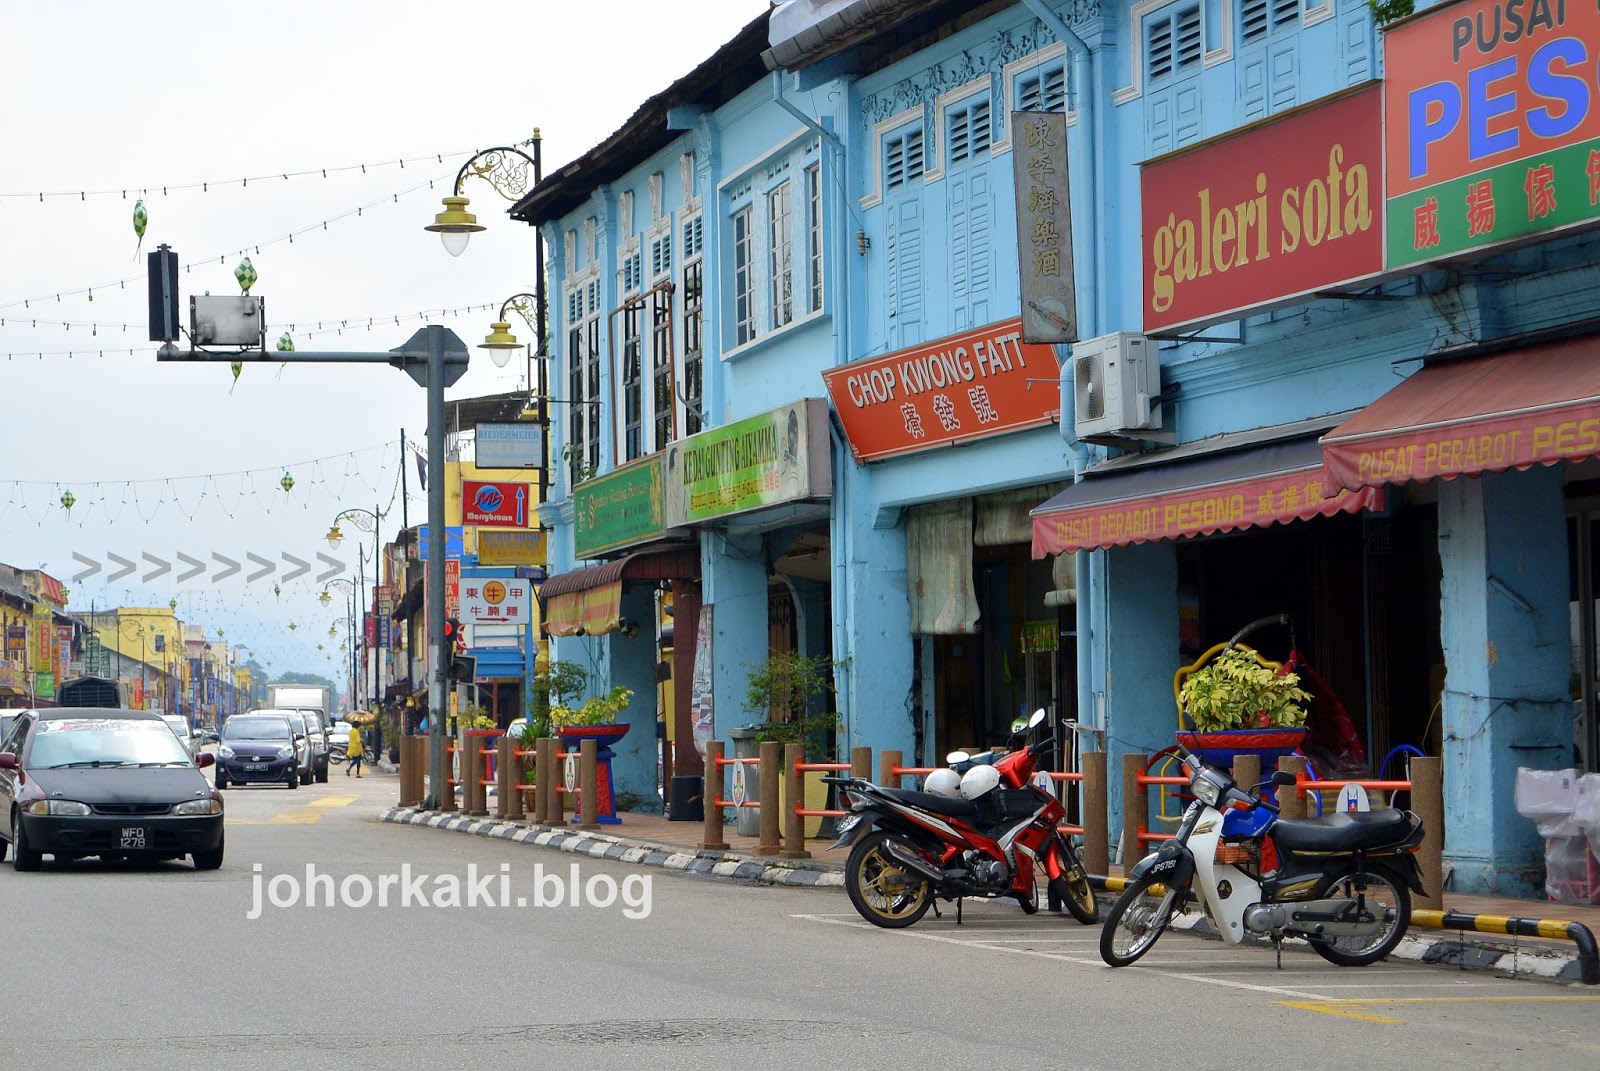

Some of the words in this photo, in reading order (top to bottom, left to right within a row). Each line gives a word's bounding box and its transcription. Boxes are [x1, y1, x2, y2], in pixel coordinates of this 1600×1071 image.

[1408, 37, 1600, 180] PES
[1152, 172, 1270, 313] galeri
[1281, 143, 1373, 255] sofa
[847, 366, 896, 408] CHOP
[897, 347, 975, 396] KWONG
[972, 331, 1026, 378] FATT
[478, 431, 540, 439] BIEDERMEIER
[1358, 445, 1418, 482] PUSAT
[1424, 430, 1522, 473] PERABOT
[683, 447, 704, 485] KEDAI
[705, 437, 740, 479] GUNTING
[467, 512, 513, 523] Marrybrown
[1057, 515, 1094, 545] PUSAT
[1101, 507, 1159, 539] PERABOT
[1164, 498, 1244, 531] PESONA
[120, 837, 146, 847] 1278
[121, 827, 144, 838] WFQ
